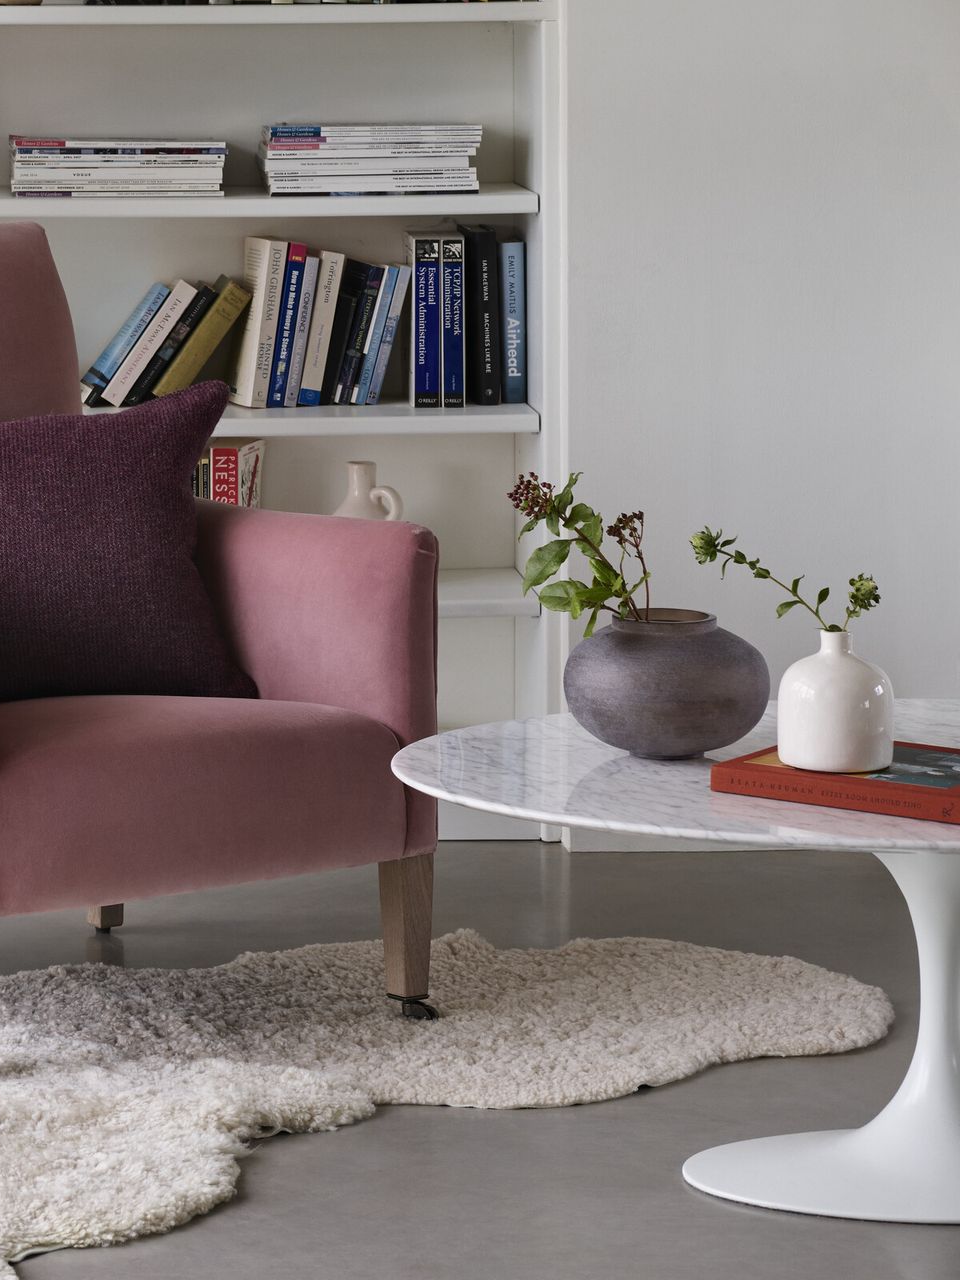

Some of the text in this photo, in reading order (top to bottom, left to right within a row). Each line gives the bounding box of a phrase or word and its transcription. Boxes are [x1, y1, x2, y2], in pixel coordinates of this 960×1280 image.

[266, 248, 282, 321] JOHN GRISHAM
[323, 260, 337, 304] Torrington
[428, 267, 436, 305] Essential
[507, 317, 522, 377] Airhead
[216, 457, 227, 503] NESS
